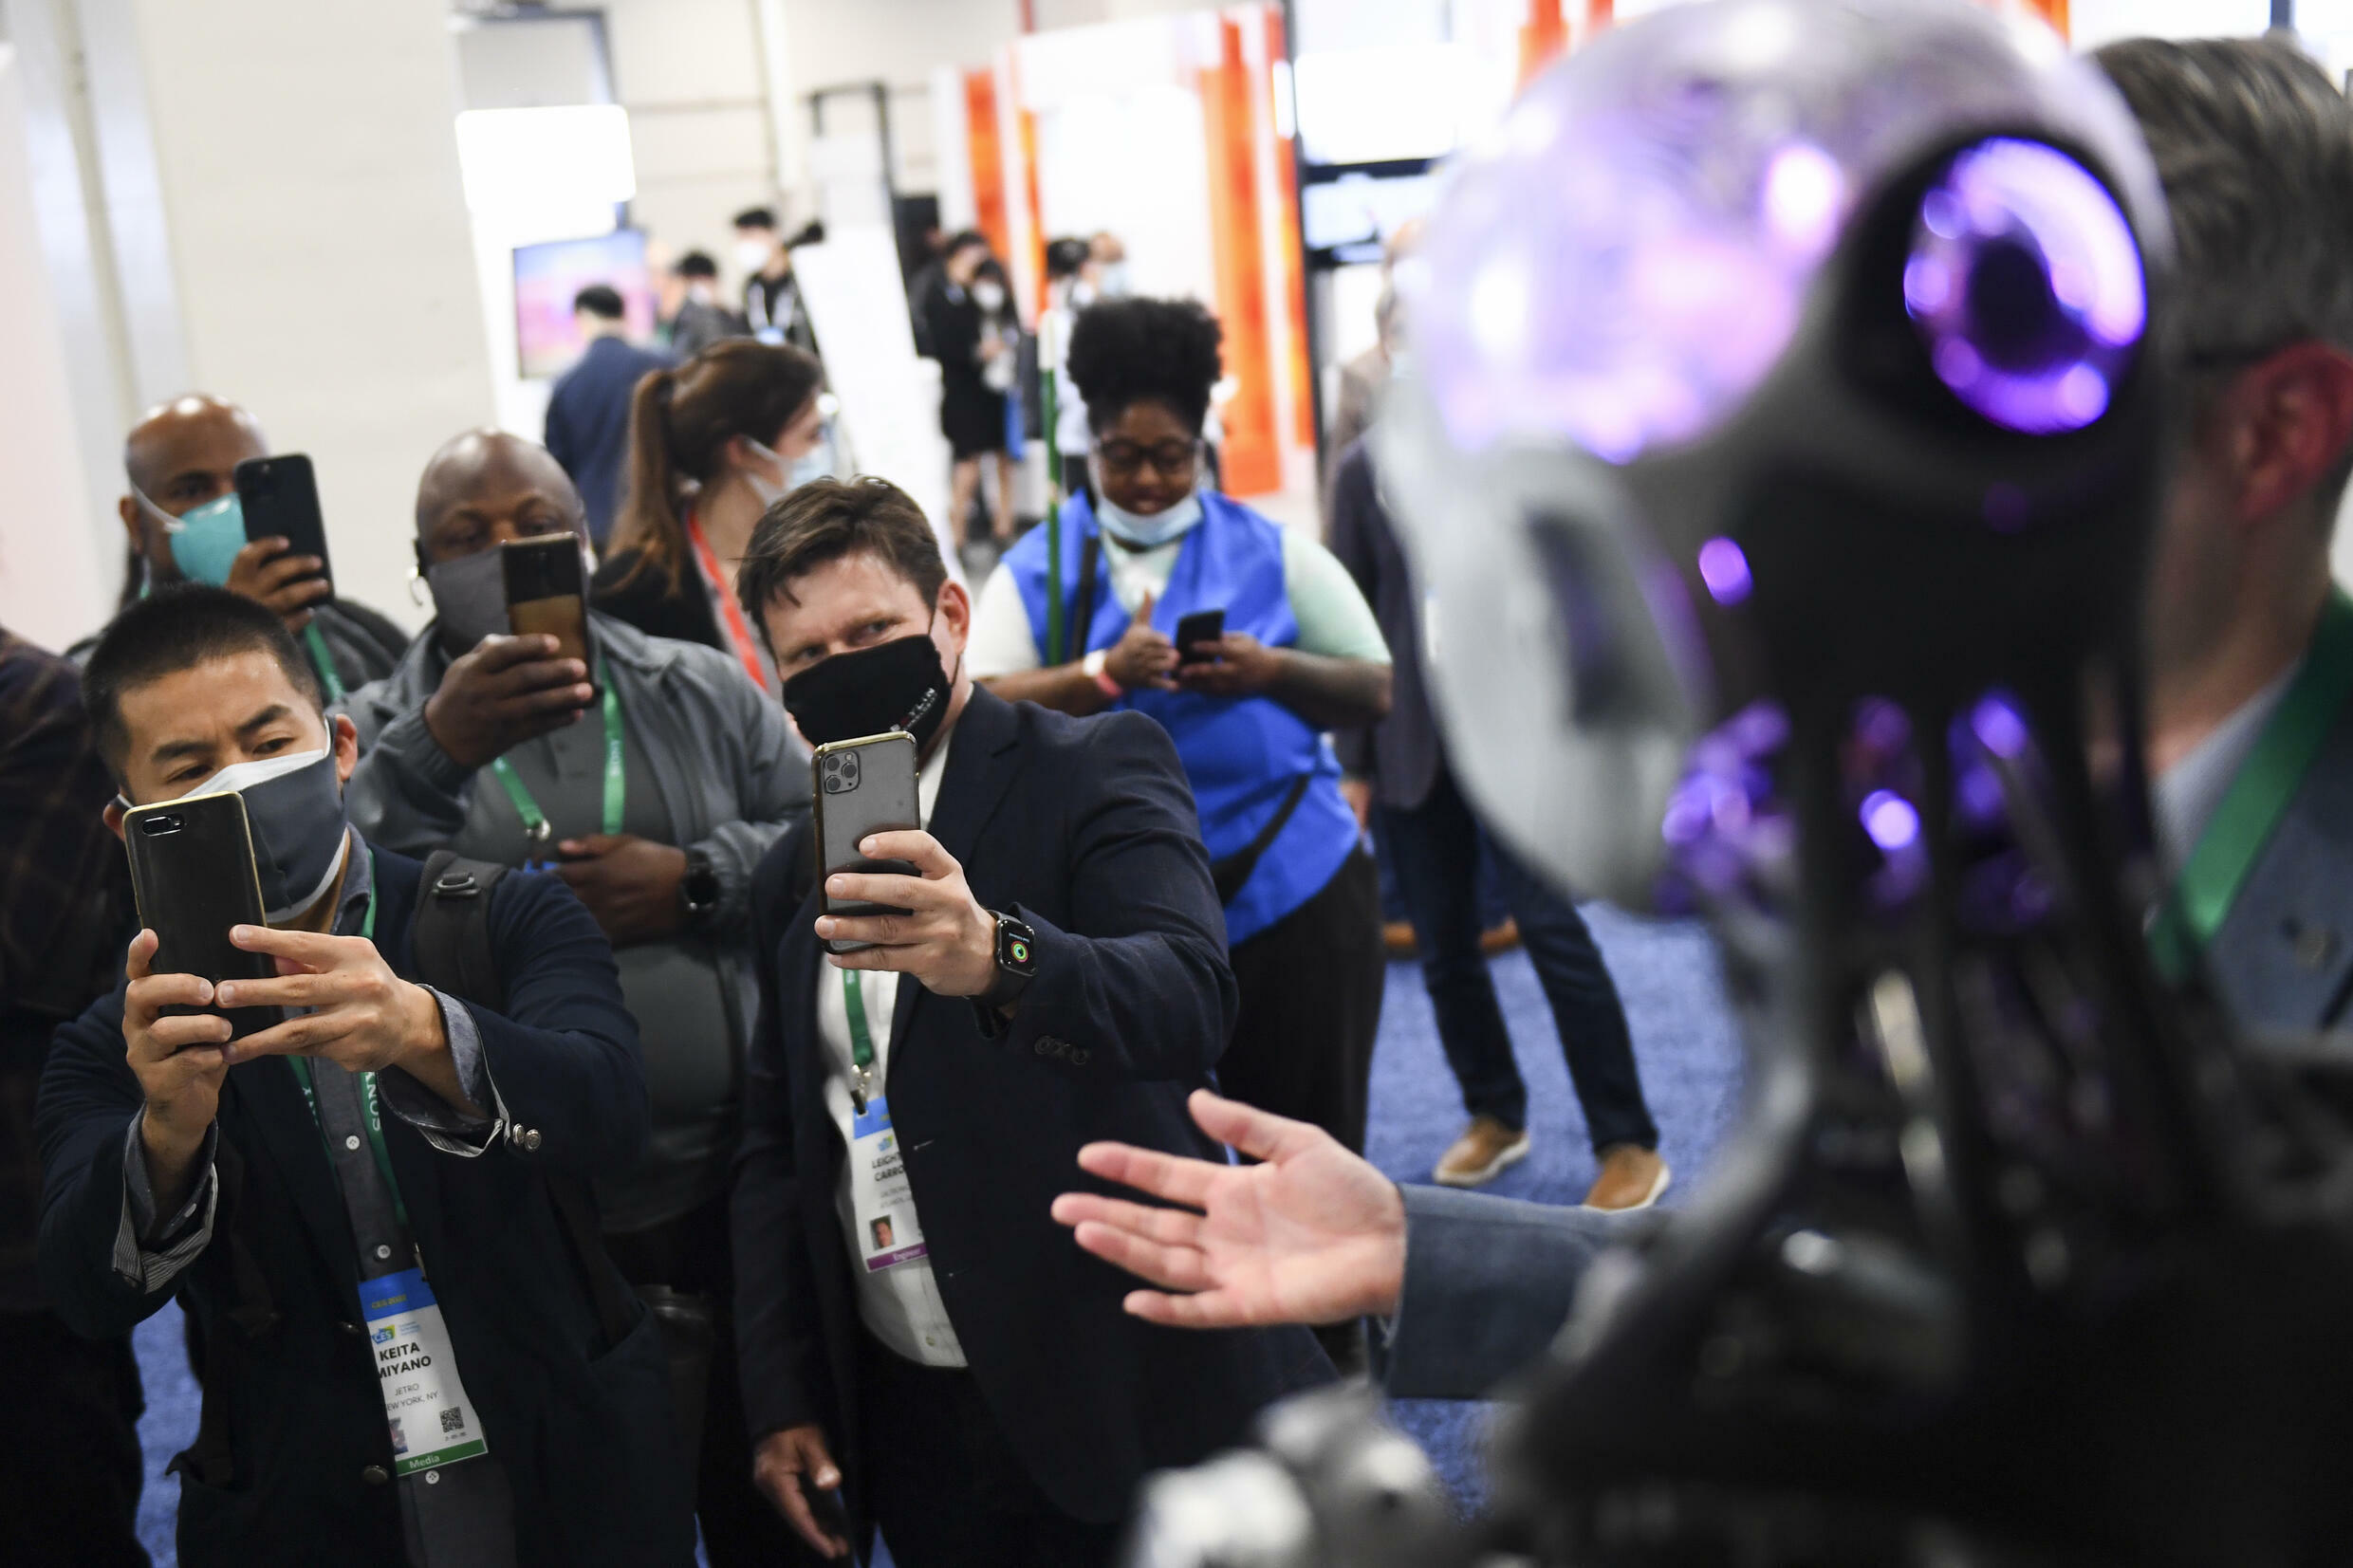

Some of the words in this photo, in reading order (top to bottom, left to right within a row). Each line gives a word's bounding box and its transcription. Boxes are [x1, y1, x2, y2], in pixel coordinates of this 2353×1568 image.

[380, 1342, 420, 1361] KEITA
[395, 1383, 419, 1396] JETRO
[387, 1402, 399, 1411] EW
[409, 1455, 440, 1468] Media
